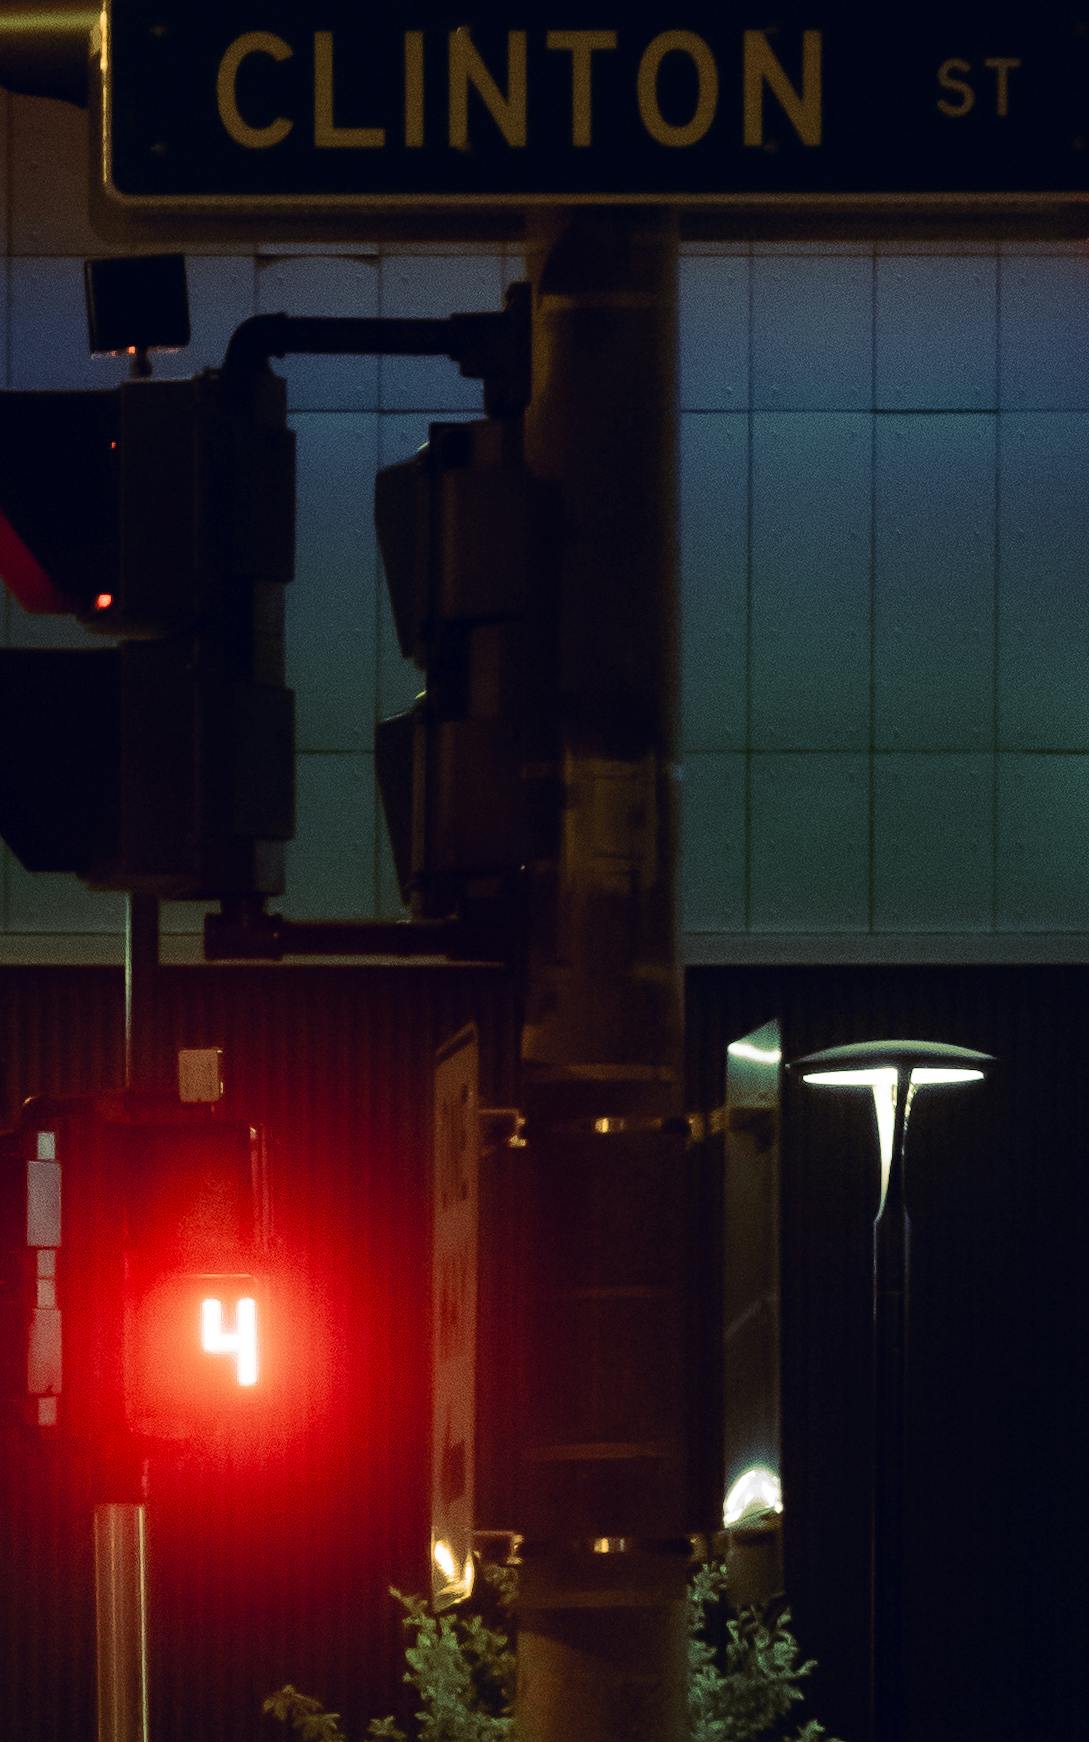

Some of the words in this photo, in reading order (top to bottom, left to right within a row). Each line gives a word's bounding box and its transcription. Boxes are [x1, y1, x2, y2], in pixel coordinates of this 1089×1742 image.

[215, 28, 823, 148] CLINTON
[936, 57, 1021, 118] ST
[200, 1297, 259, 1387] 4
